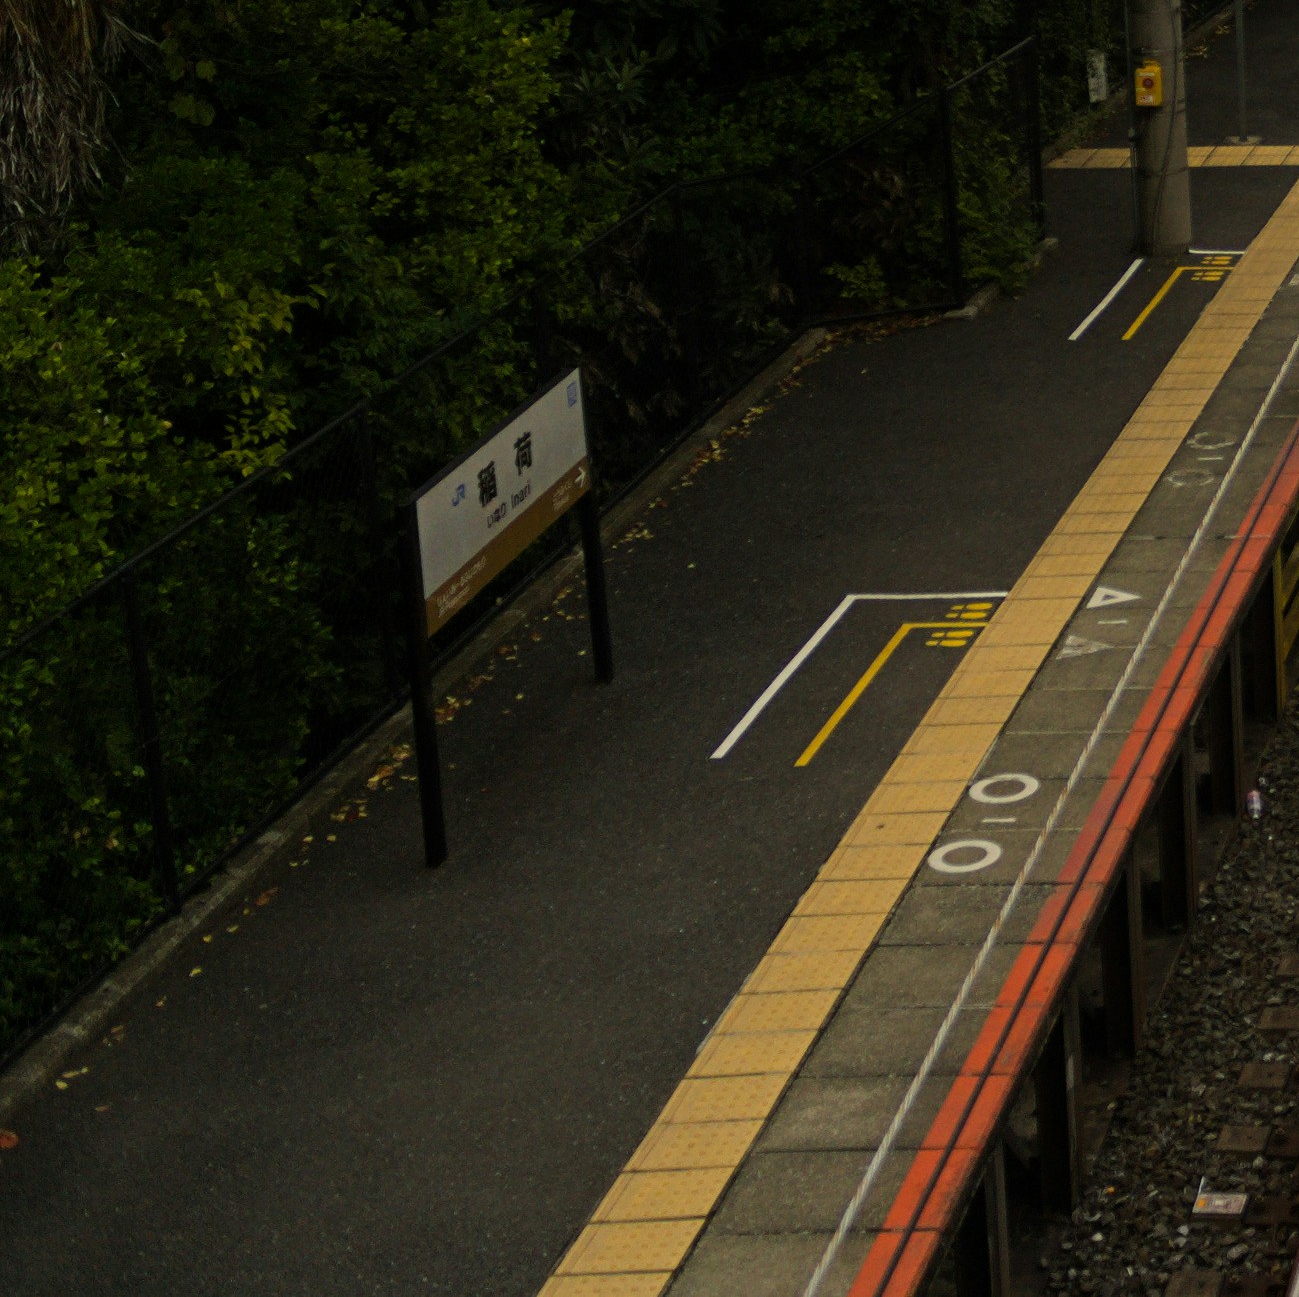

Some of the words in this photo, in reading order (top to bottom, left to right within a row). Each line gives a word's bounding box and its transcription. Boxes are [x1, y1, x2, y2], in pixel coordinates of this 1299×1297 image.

[477, 431, 532, 508] 稲荷
[452, 483, 466, 507] JR
[511, 479, 531, 508] Inari
